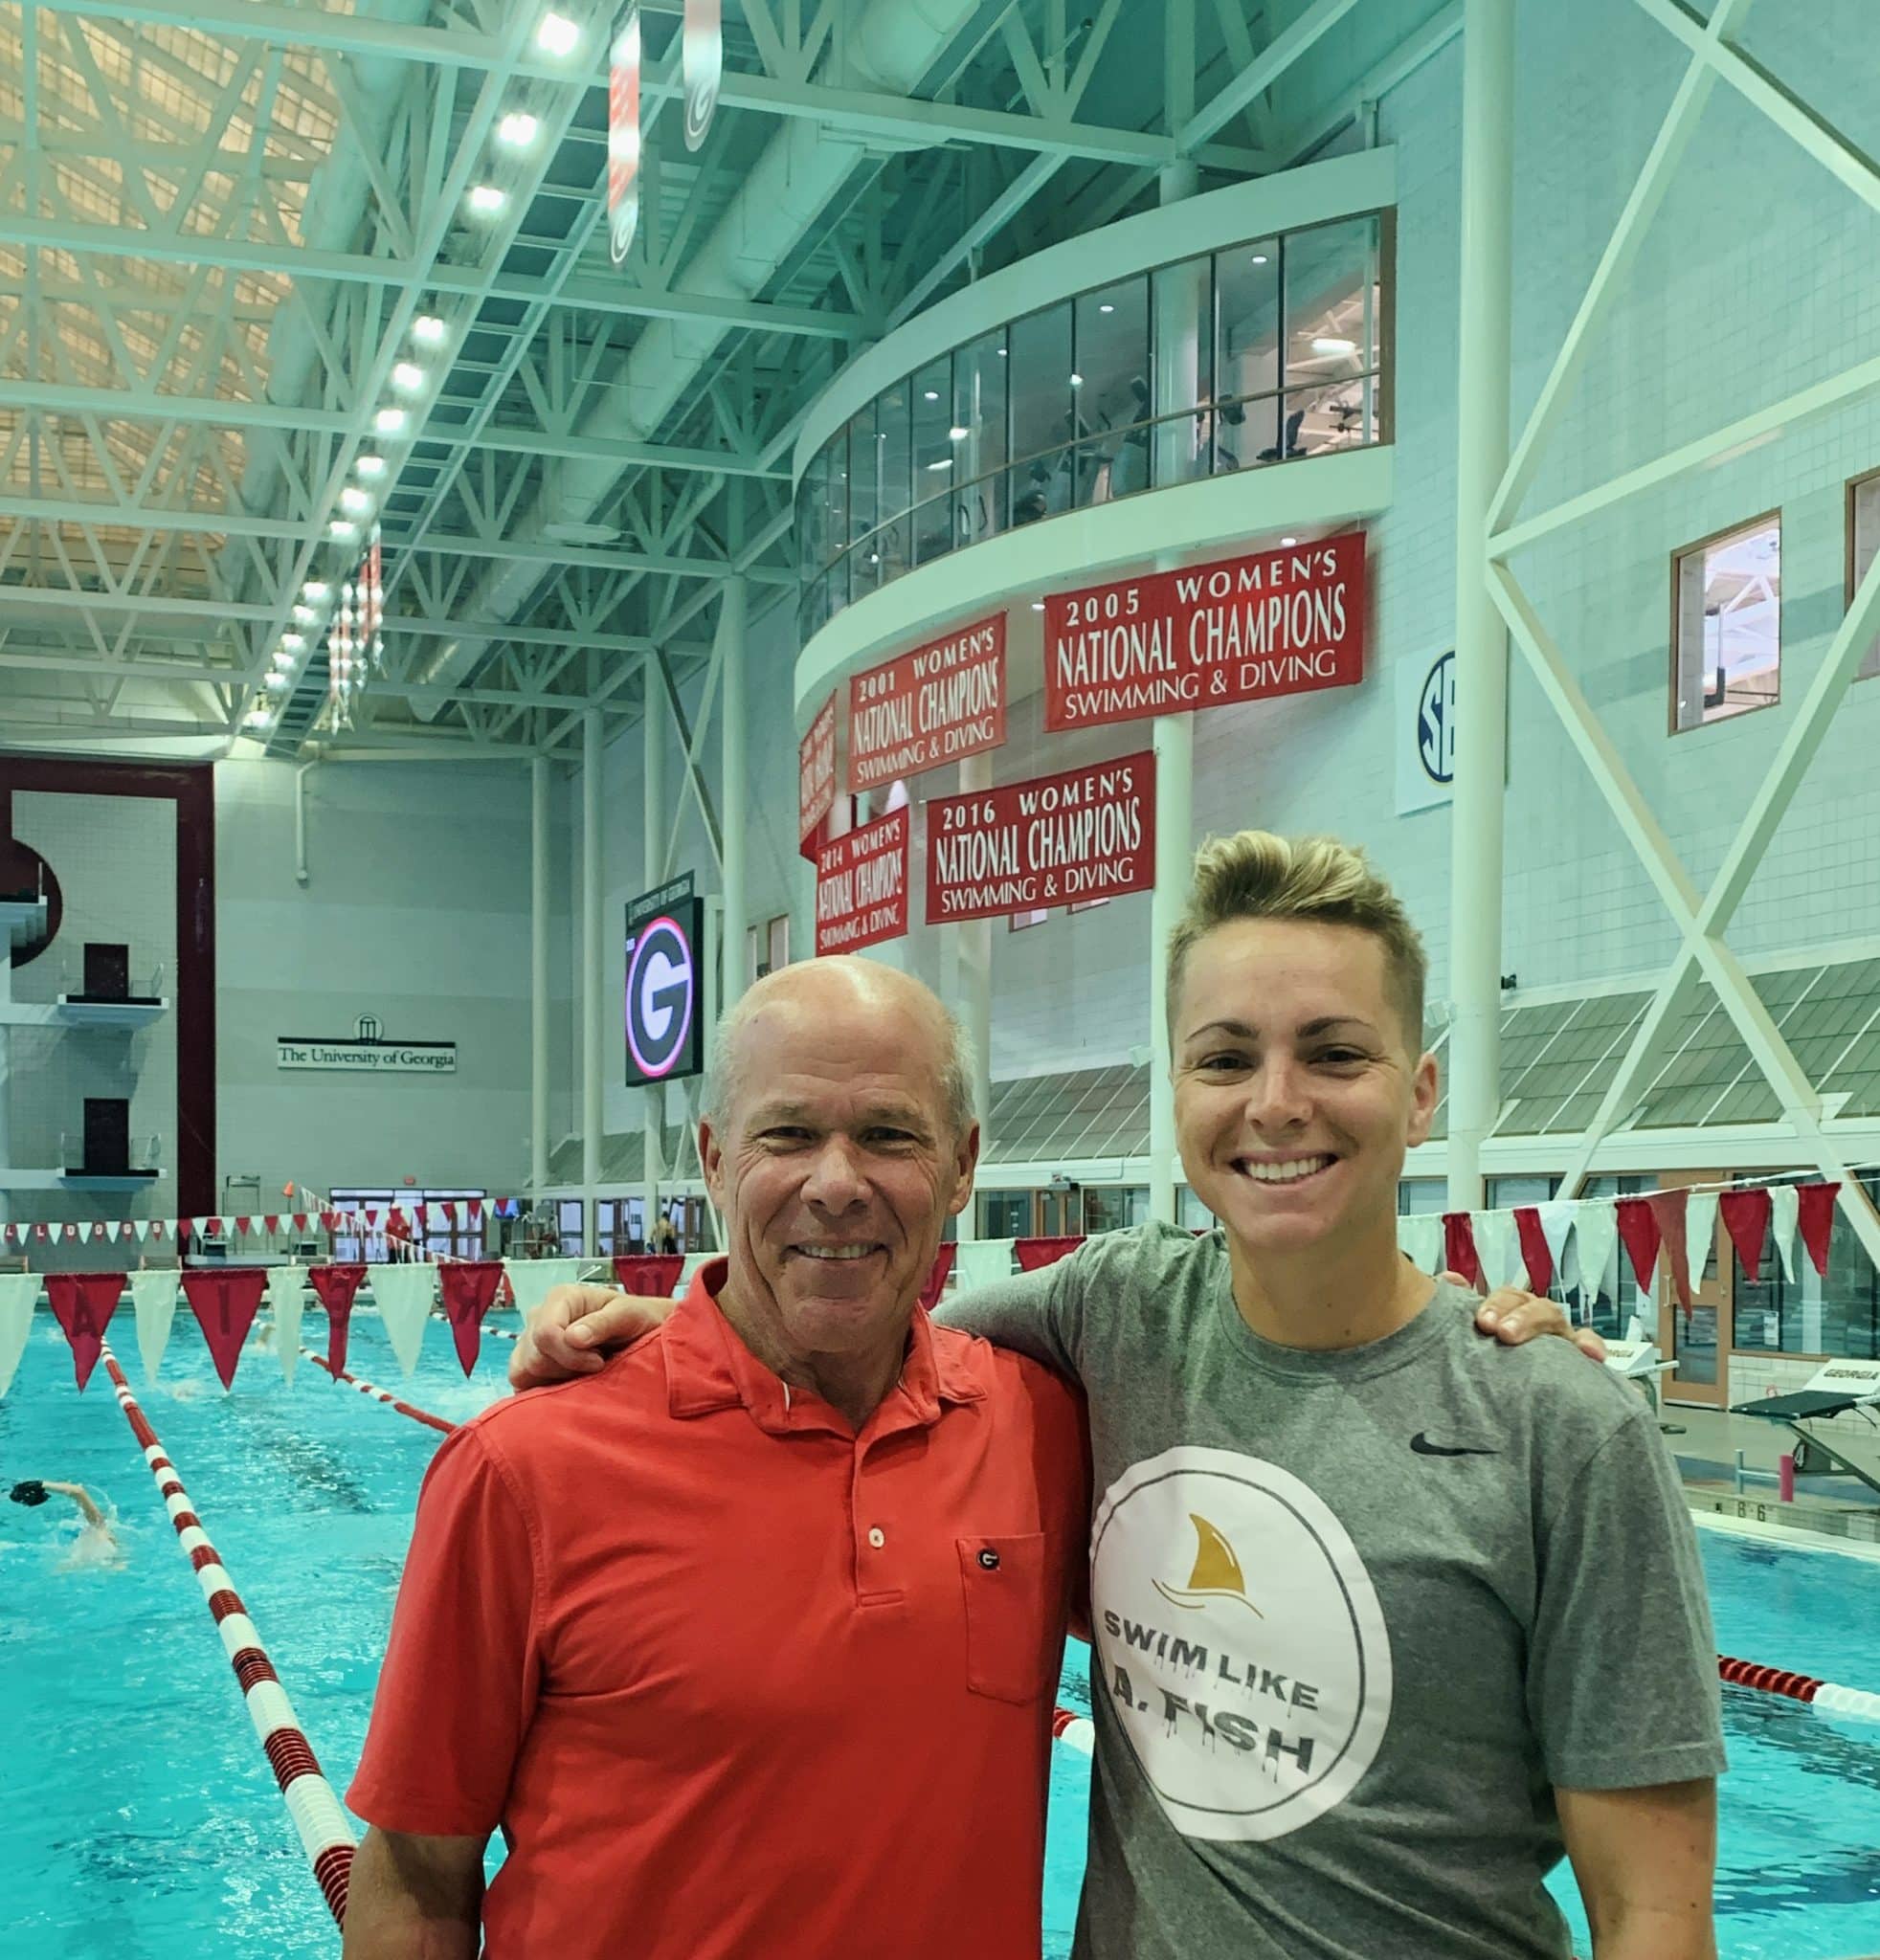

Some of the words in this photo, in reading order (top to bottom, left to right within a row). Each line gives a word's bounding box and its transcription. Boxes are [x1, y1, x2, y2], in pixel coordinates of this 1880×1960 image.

[1066, 589, 1139, 627] 2005
[1175, 548, 1336, 604] WOMEN'S
[860, 671, 895, 702] 2001
[913, 627, 995, 679] WOMEN'S
[1057, 617, 1177, 688] NATIONAL
[1189, 583, 1346, 665] CHAMPIONS
[854, 692, 913, 757] NATIONAL
[919, 657, 998, 733] CHAMPIONS
[1064, 673, 1198, 719] SWIMMING
[1210, 670, 1228, 695] &
[1241, 649, 1335, 690] DIVING
[858, 741, 926, 783] SWIMMING
[929, 736, 940, 759] &
[945, 716, 994, 754] DIVING
[943, 800, 996, 831] 2016
[1019, 768, 1132, 816] WOMEN'S
[936, 825, 1019, 885] NATIONAL
[1028, 796, 1141, 872] CHAMPIONS
[942, 877, 1037, 913] SWIMMING
[1044, 874, 1058, 898] &
[1065, 858, 1133, 894] DIVING
[279, 1048, 306, 1062] The
[311, 1049, 380, 1067] University
[383, 1051, 397, 1064] of
[400, 1052, 455, 1069] Georgia
[1824, 1369, 1879, 1380] GEORGIA
[1794, 1444, 1804, 1467] 4
[1104, 1610, 1207, 1675] SWIM
[1219, 1655, 1319, 1715] LIKE
[1112, 1663, 1149, 1712] A.
[1158, 1688, 1315, 1778] FISH
